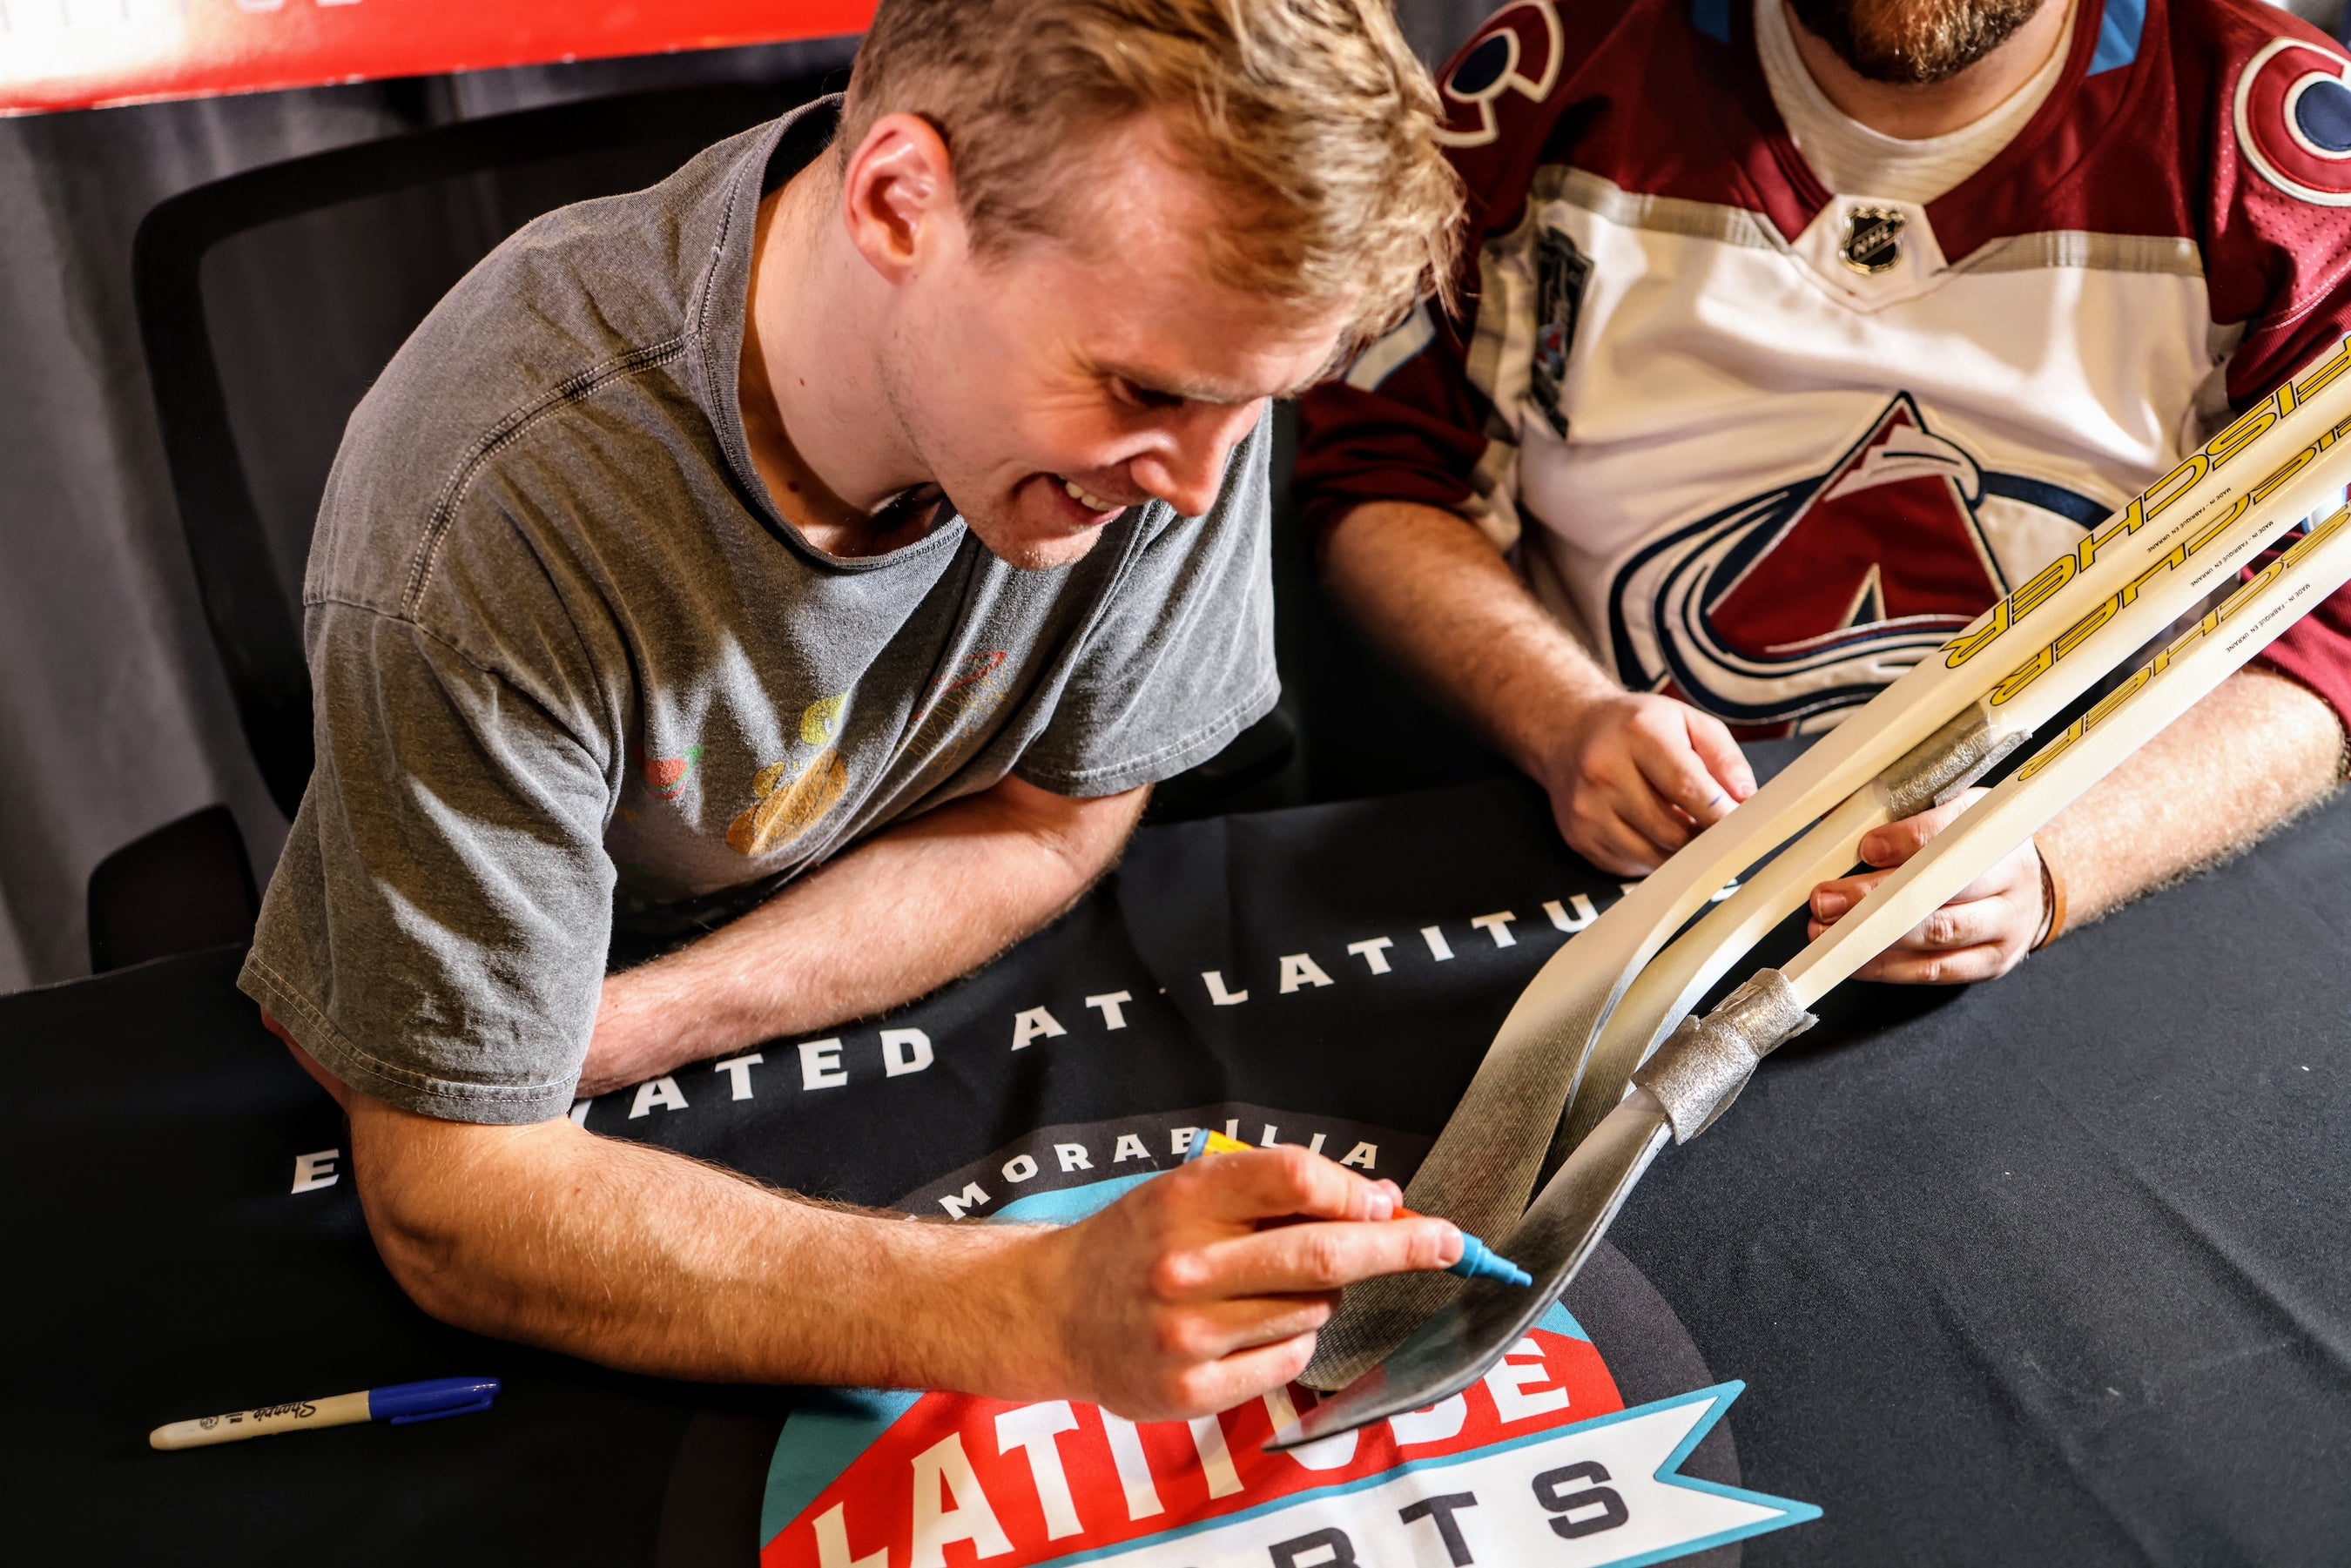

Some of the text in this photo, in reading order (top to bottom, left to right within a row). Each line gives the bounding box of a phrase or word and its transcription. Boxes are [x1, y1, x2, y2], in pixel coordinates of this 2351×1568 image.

[1852, 224, 1890, 257] NHL
[1937, 334, 2351, 669] FISCHER
[2215, 487, 2232, 501] MADE
[2171, 526, 2180, 535] EN
[2251, 531, 2259, 540] IN
[2257, 520, 2274, 535] MADE
[2146, 533, 2171, 554] UKRAINE
[1988, 414, 2351, 706] ISCHER
[2213, 560, 2223, 569] EN
[2189, 567, 2214, 588] UKRAINE
[2294, 583, 2311, 598] MADE
[2249, 624, 2260, 634] EN
[2225, 632, 2250, 654] UKRAINE
[1011, 989, 1134, 1051] AT
[1201, 878, 1742, 1006] LATITU
[904, 1118, 1378, 1222] MORABILIA
[252, 1401, 317, 1422] Sharpie
